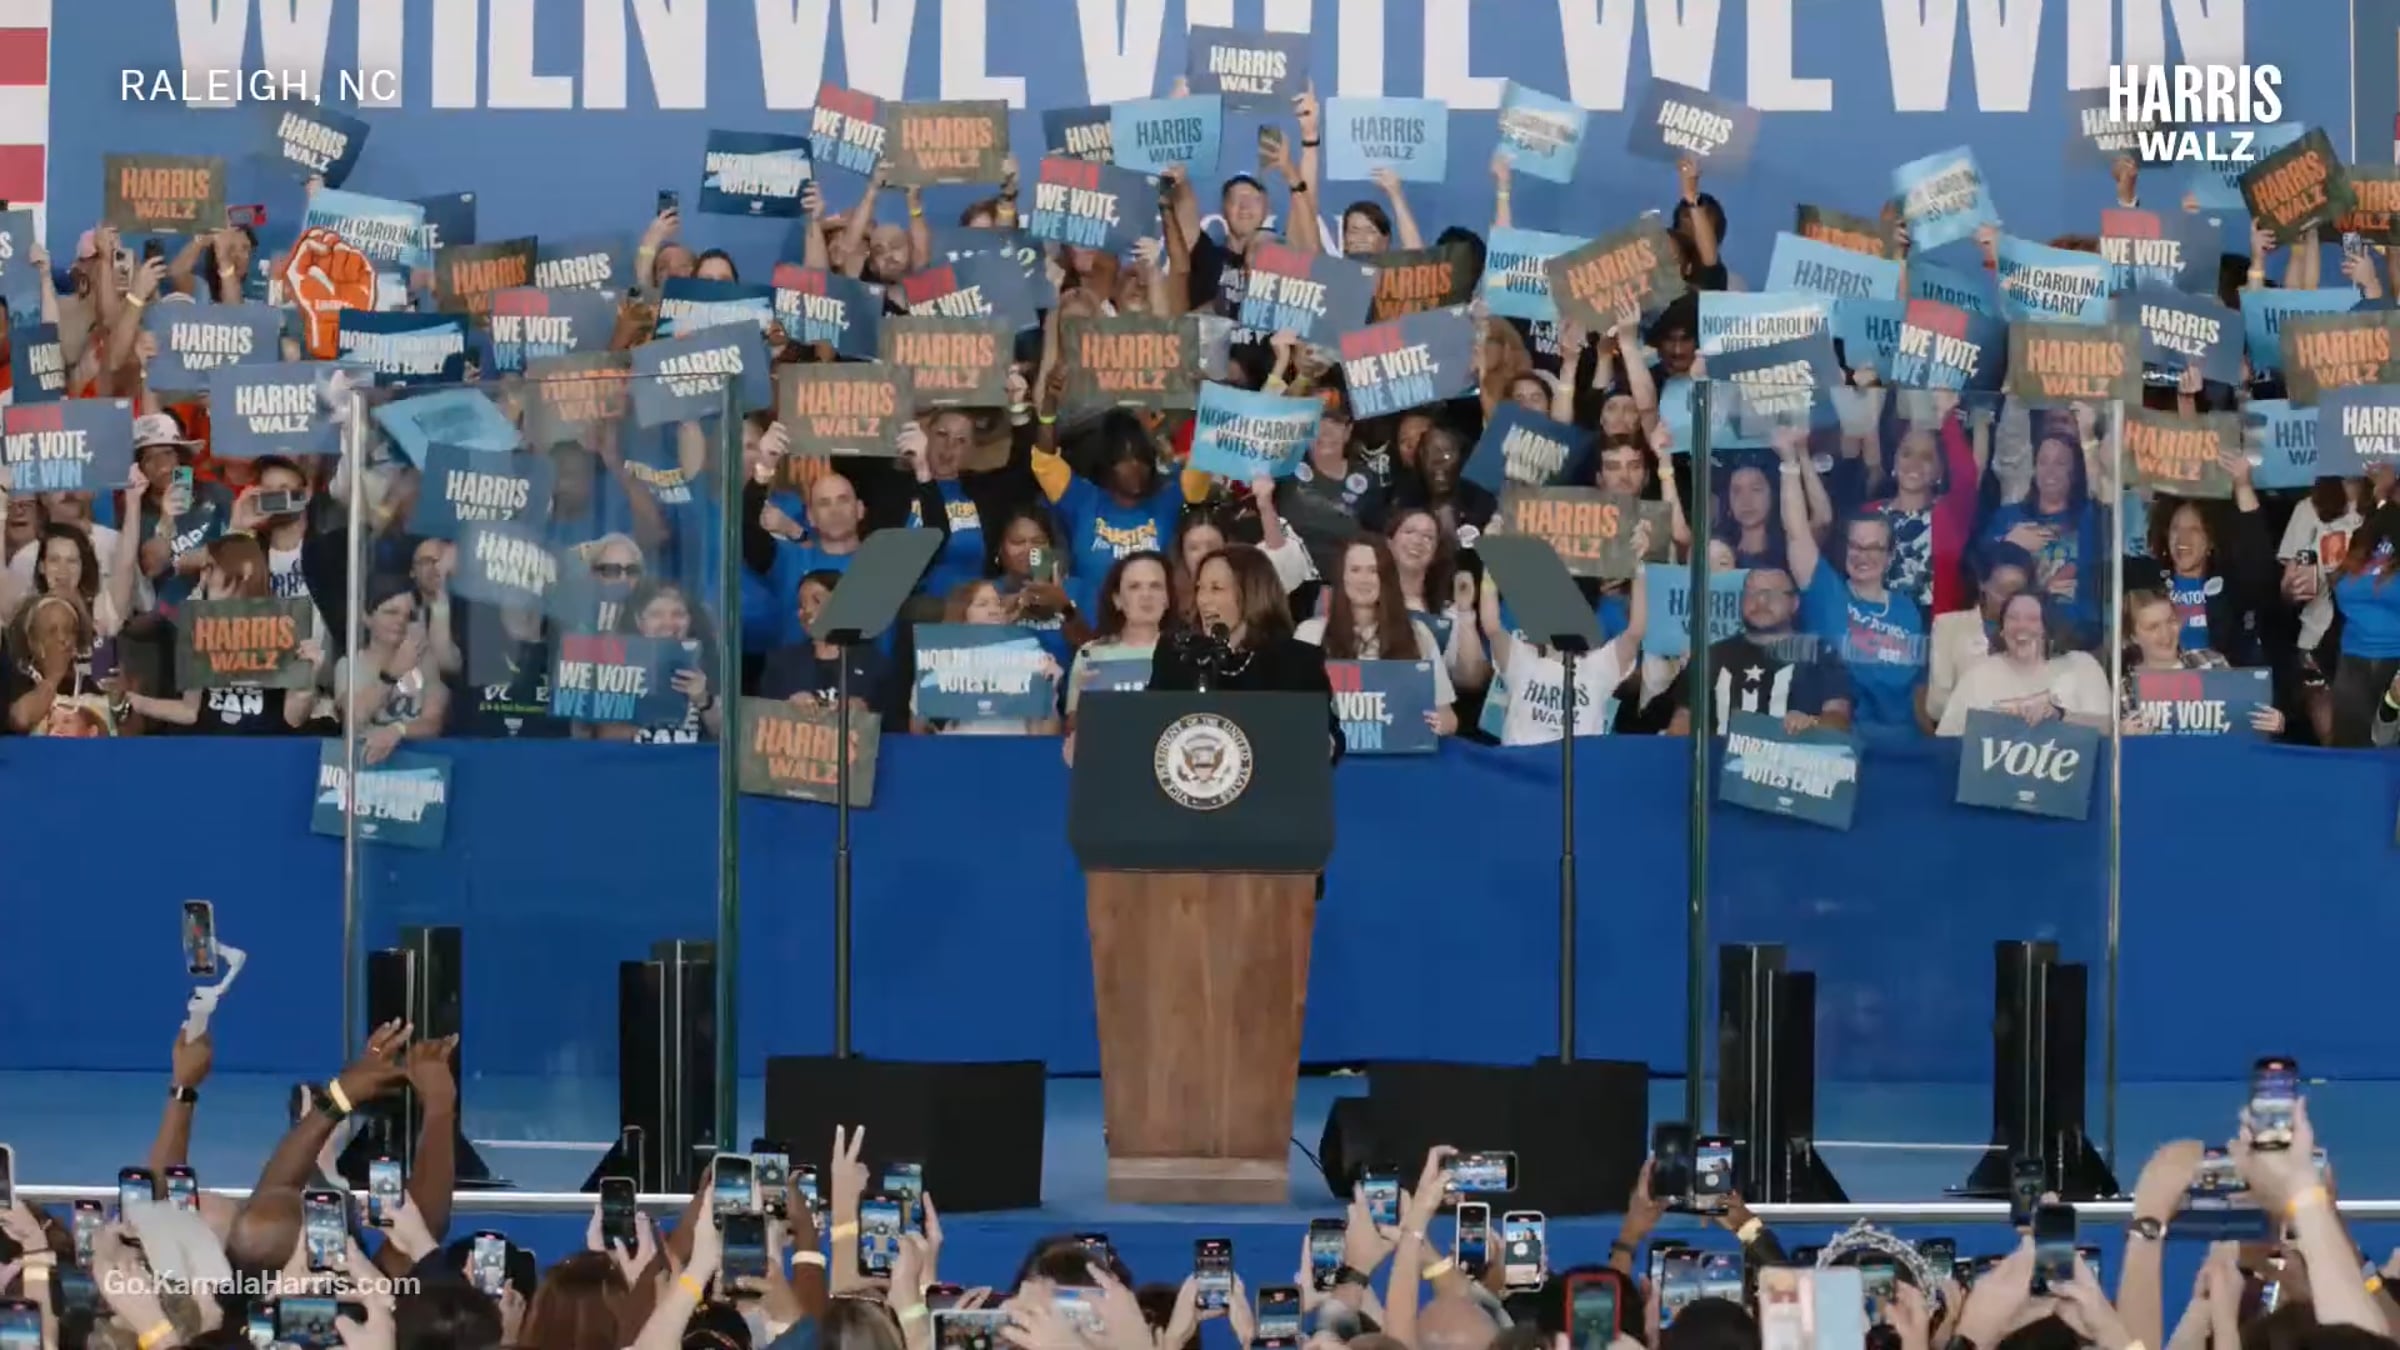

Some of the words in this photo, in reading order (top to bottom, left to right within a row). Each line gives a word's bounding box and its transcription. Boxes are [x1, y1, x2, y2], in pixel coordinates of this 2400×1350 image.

[1209, 45, 1288, 80] HARRIS
[1220, 76, 1274, 95] WALZ
[278, 111, 349, 159] HARRIS
[811, 106, 841, 137] WE
[903, 116, 993, 151] HARRIS
[1136, 117, 1203, 147] HARRIS
[1350, 116, 1426, 145] HARRIS
[1657, 100, 1733, 144] HARRIS
[283, 143, 332, 172] WALZ
[1149, 146, 1196, 163] WALZ
[1362, 144, 1417, 161] WALZ
[1663, 127, 1714, 156] WALZ
[916, 150, 980, 169] WALZ
[121, 167, 210, 200] HARRIS
[2251, 150, 2328, 215] HARRIS
[134, 199, 199, 219] WALZ
[1036, 182, 1068, 213] WE
[1069, 188, 1121, 227] VOTE,
[2272, 183, 2329, 226] WALZ
[1031, 210, 1063, 241] WE
[1066, 215, 1110, 248] WIN
[535, 252, 612, 290] HARRIS
[1488, 251, 1540, 275] NORTH
[1567, 237, 1658, 300] HARRIS
[2101, 237, 2133, 264] WE
[2134, 239, 2187, 274] VOTE,
[452, 255, 528, 295] HARRIS
[1375, 262, 1452, 299] ARRIS
[1505, 273, 1549, 297] VOTES
[1793, 259, 1873, 299] HARRIS
[2033, 269, 2105, 299] CAROLINA
[775, 286, 801, 314] WE
[803, 293, 850, 331] VOTE,
[1247, 268, 1279, 301] WE
[1278, 275, 1327, 317] VOTE,
[2042, 291, 2087, 316] EARLY
[172, 322, 253, 354] HARRIS
[492, 316, 521, 343] WE
[523, 316, 578, 347] VOTE,
[1702, 315, 1750, 336] NORTH
[1755, 315, 1829, 337] CAROLINA
[2140, 304, 2221, 344] HARRIS
[896, 332, 995, 367] HARRIS
[1080, 333, 1182, 369] HARRIS
[1898, 324, 1929, 358] WE
[1934, 335, 1981, 376] VOTE,
[2027, 339, 2125, 377] HARRIS
[2151, 330, 2206, 357] WALZ
[2296, 326, 2390, 367] HARRIS
[913, 367, 980, 390] WALZ
[1095, 370, 1167, 391] WALZ
[1346, 353, 1384, 388] WE
[1383, 343, 1440, 377] VOTE,
[2313, 361, 2379, 389] WALZ
[236, 383, 317, 416] HARRIS
[797, 381, 896, 417] HARRIS
[2042, 375, 2110, 398] WALZ
[249, 415, 310, 435] WALZ
[811, 417, 881, 438] WALZ
[2275, 420, 2317, 448] HAR
[2343, 406, 2400, 437] HARR
[5, 432, 35, 462] WE
[37, 429, 94, 463] VOTE,
[1216, 430, 1258, 460] VOTES
[2124, 417, 2220, 461] HARRIS
[2353, 436, 2400, 454] WAL
[40, 461, 83, 490] WIN
[2135, 452, 2201, 481] WALZ
[446, 469, 531, 507] HARRIS
[1515, 499, 1620, 539] HARRIS
[1541, 534, 1601, 559] ALZ
[193, 615, 296, 651] HARRIS
[209, 650, 280, 672] WALZ
[558, 660, 595, 690] WE
[597, 663, 649, 698] VOTE,
[553, 688, 591, 719] WE
[593, 691, 637, 720] WIN
[1334, 691, 1394, 726] VOTE,
[2139, 700, 2173, 730] WE
[2176, 700, 2232, 733] VOTE,
[754, 716, 859, 764] HARRS
[1981, 735, 2080, 782] vote
